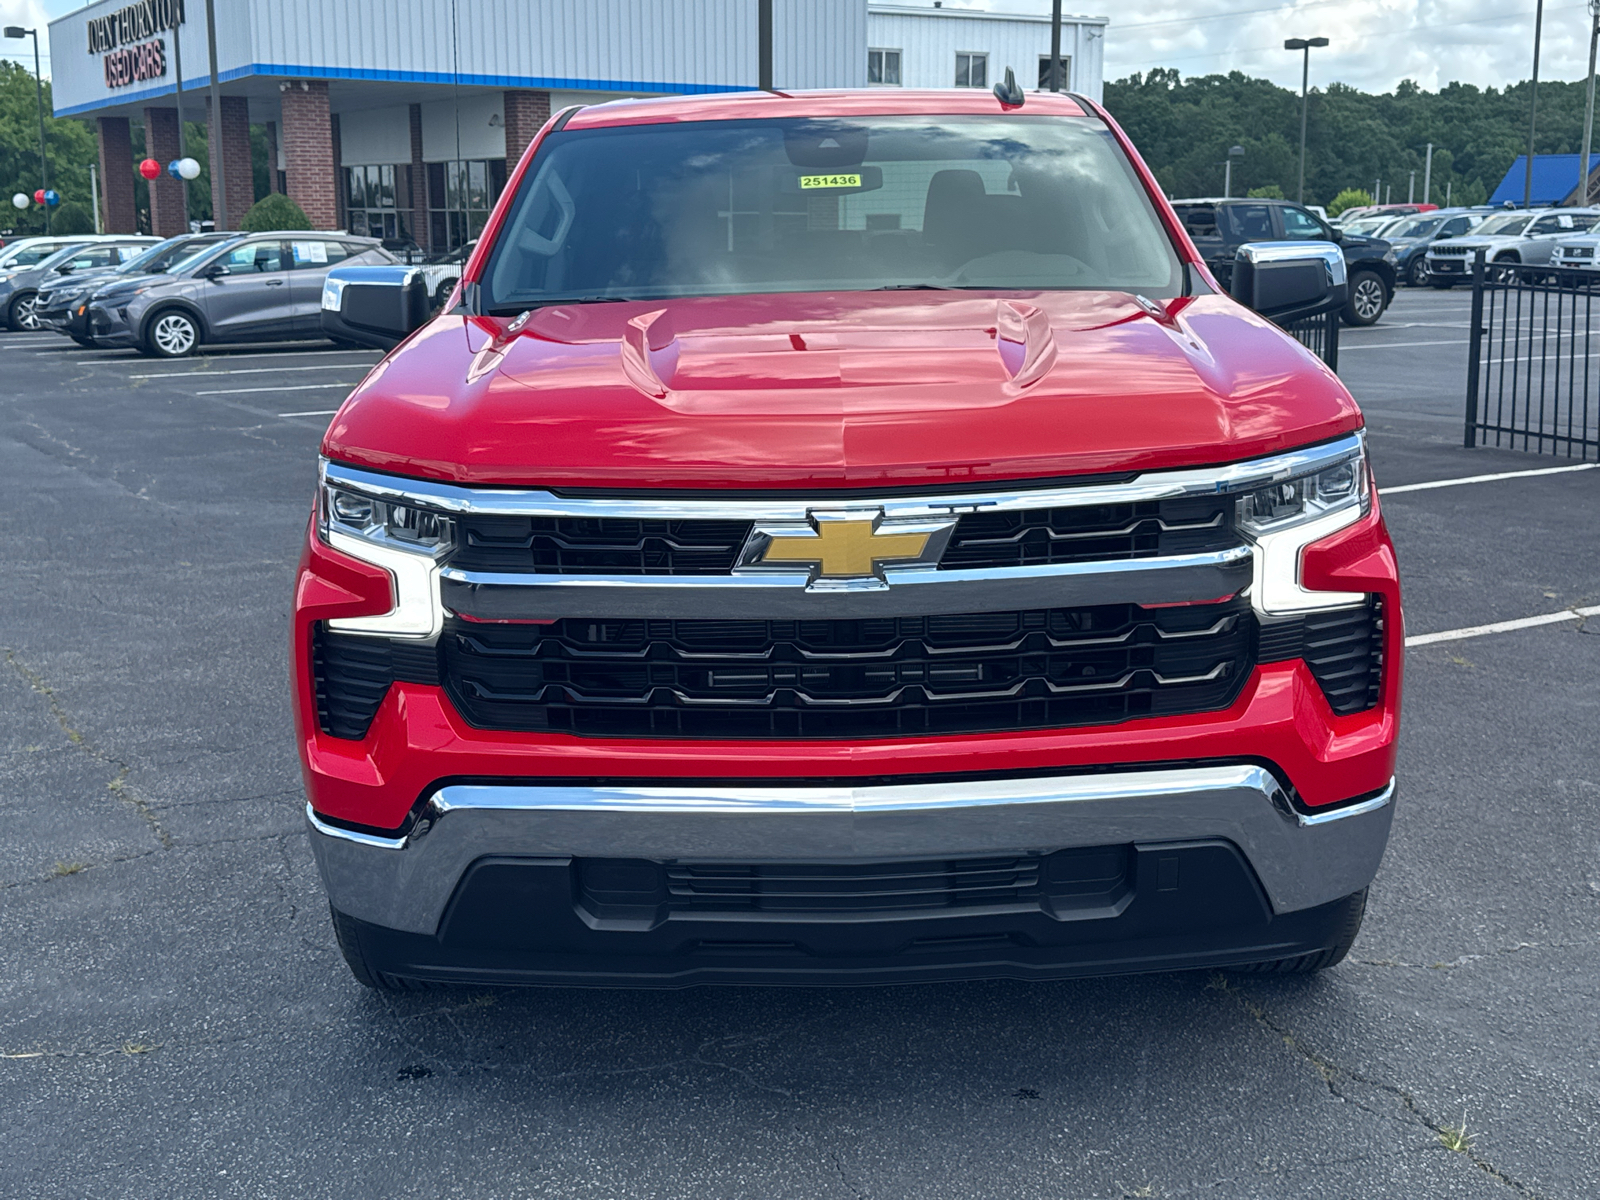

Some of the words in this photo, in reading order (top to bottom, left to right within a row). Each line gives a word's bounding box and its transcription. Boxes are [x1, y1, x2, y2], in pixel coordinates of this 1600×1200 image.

[86, 13, 116, 54] JOHN
[103, 49, 133, 88] USED
[131, 39, 166, 81] CARS
[803, 176, 857, 187] 251436
